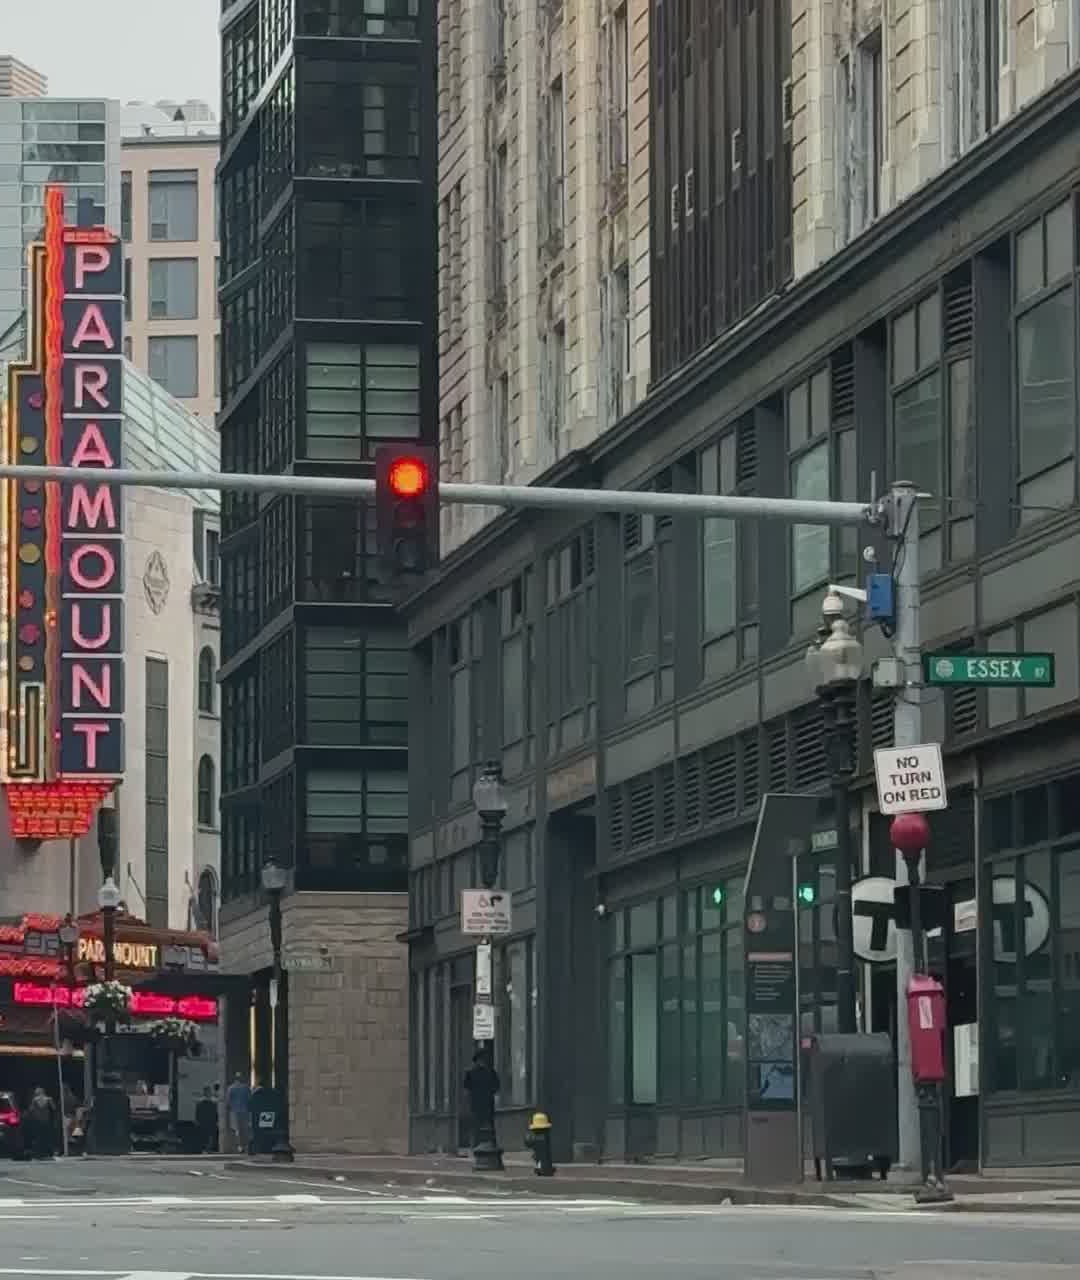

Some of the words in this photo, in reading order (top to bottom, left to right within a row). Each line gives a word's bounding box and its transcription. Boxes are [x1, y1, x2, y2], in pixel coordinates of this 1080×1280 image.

[68, 245, 116, 769] PARAMOUNT
[967, 659, 1022, 678] ESSEX
[896, 755, 919, 769] NO
[890, 771, 932, 787] TURN
[883, 791, 906, 804] ON
[910, 787, 941, 801] RED
[78, 938, 157, 967] PARMOUNT
